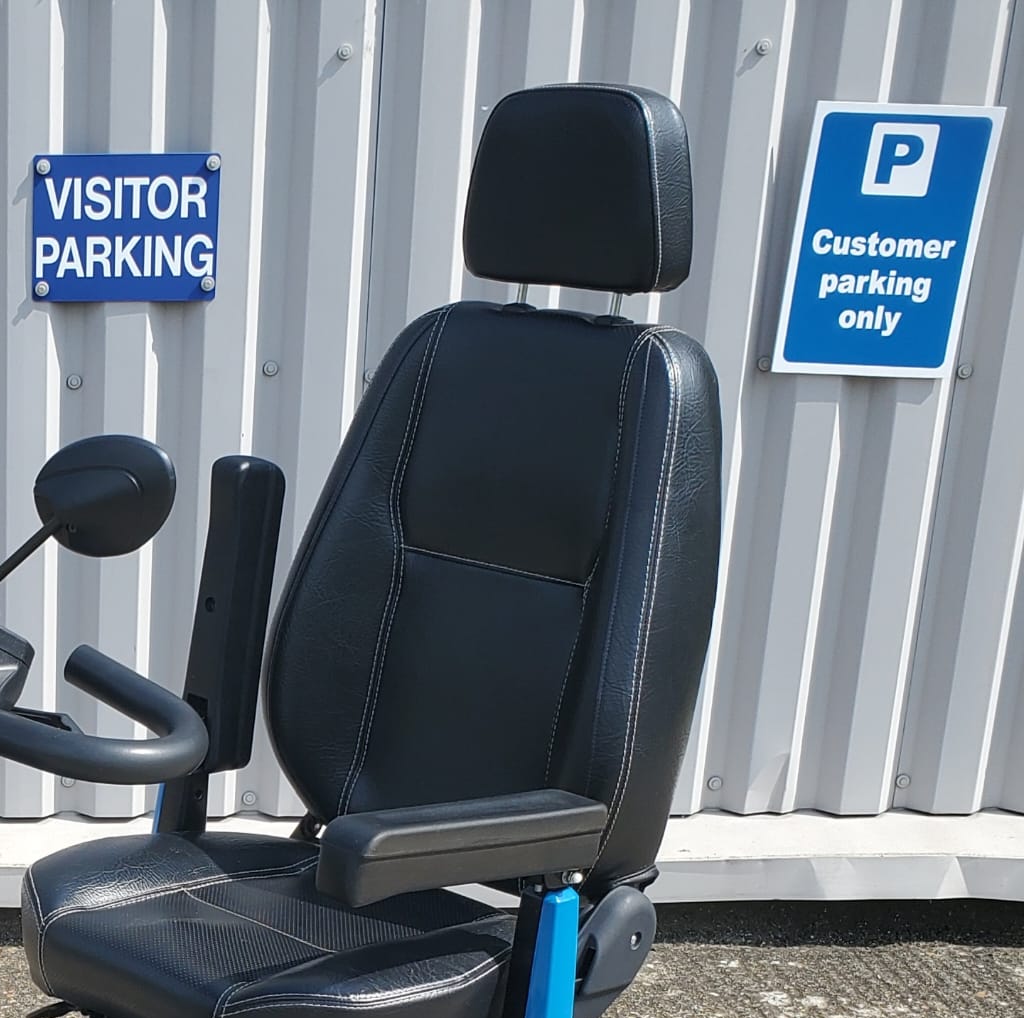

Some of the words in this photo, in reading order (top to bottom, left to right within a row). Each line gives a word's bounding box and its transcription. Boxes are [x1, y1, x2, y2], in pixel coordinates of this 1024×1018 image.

[873, 133, 925, 185] P
[44, 175, 208, 221] VISITOR
[35, 233, 214, 279] PARKING
[812, 228, 956, 259] Customer
[818, 269, 932, 303] parking
[838, 305, 902, 337] only
